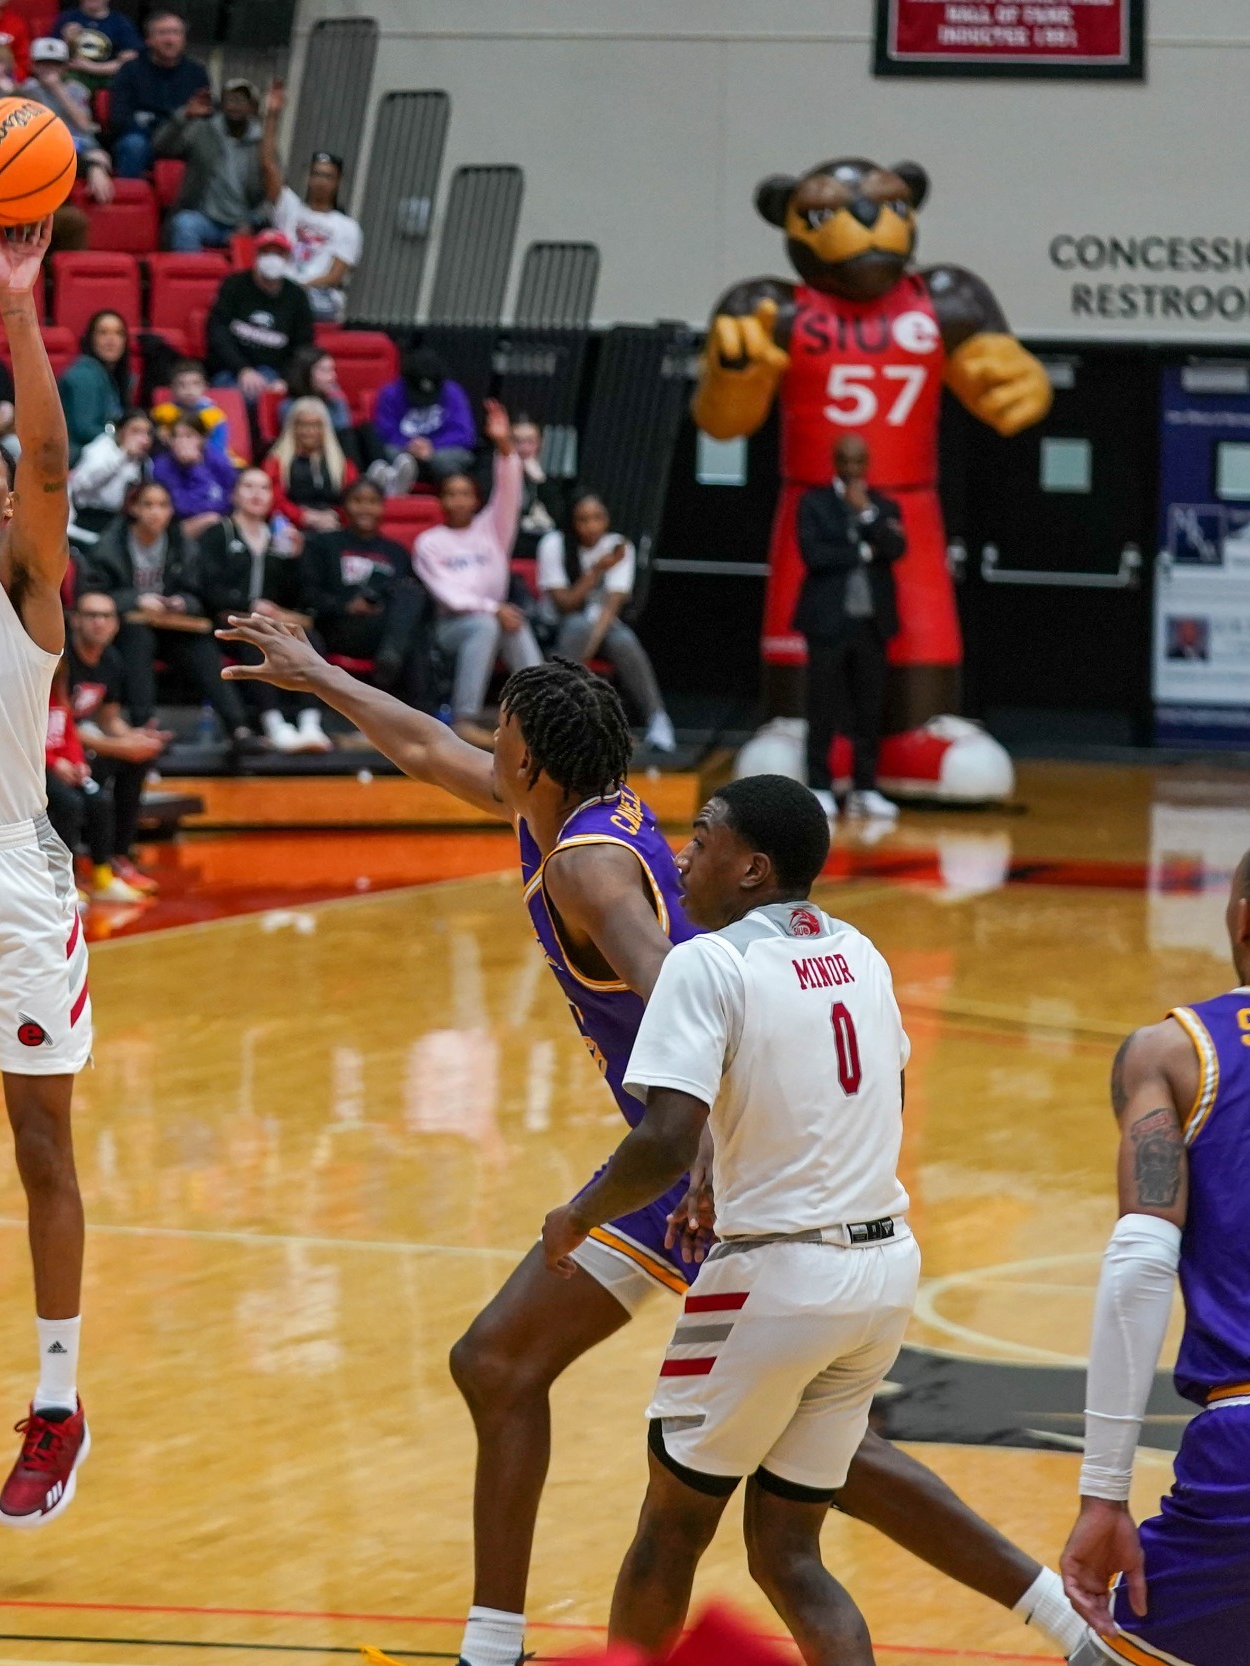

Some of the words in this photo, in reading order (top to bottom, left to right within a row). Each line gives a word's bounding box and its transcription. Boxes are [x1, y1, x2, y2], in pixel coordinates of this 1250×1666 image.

[1048, 234, 1250, 273] CONCESSI
[1071, 281, 1250, 323] RESTROO
[823, 364, 928, 427] 57
[792, 953, 855, 990] MINOR
[831, 1000, 862, 1098] 0
